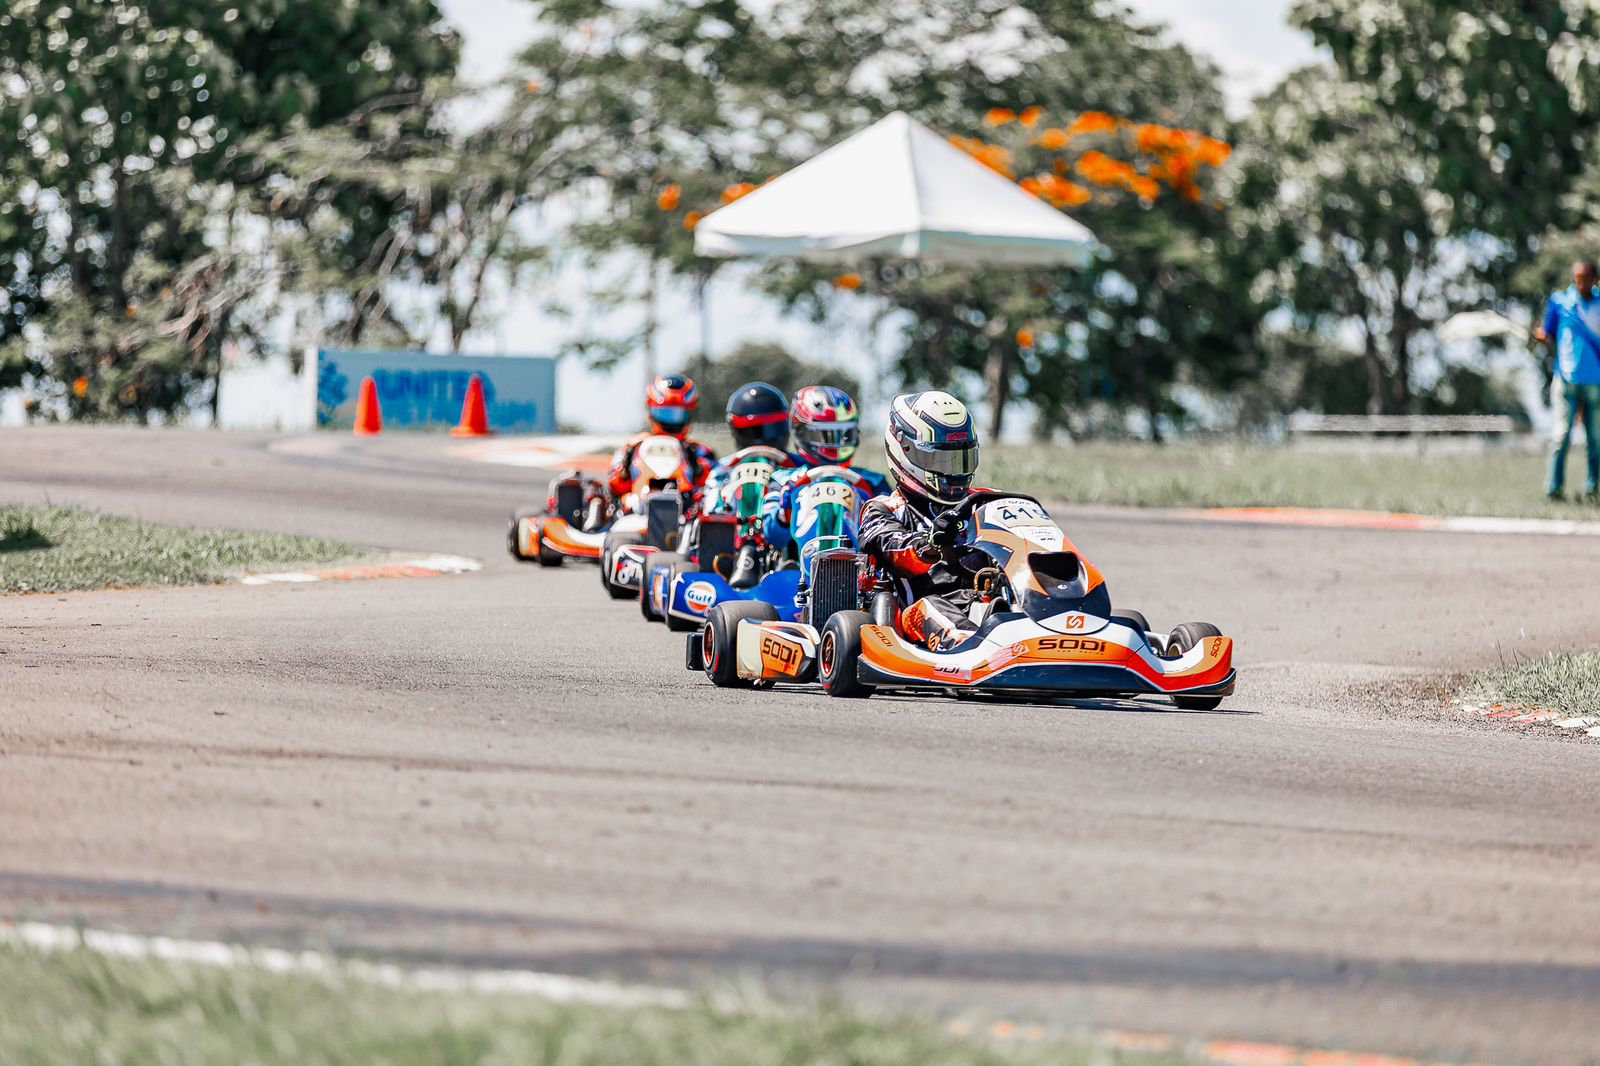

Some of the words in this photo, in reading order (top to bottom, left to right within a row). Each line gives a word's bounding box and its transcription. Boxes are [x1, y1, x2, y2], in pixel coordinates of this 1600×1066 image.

[687, 590, 714, 605] Gulf
[762, 637, 799, 665] SODI
[1037, 635, 1107, 652] SODI
